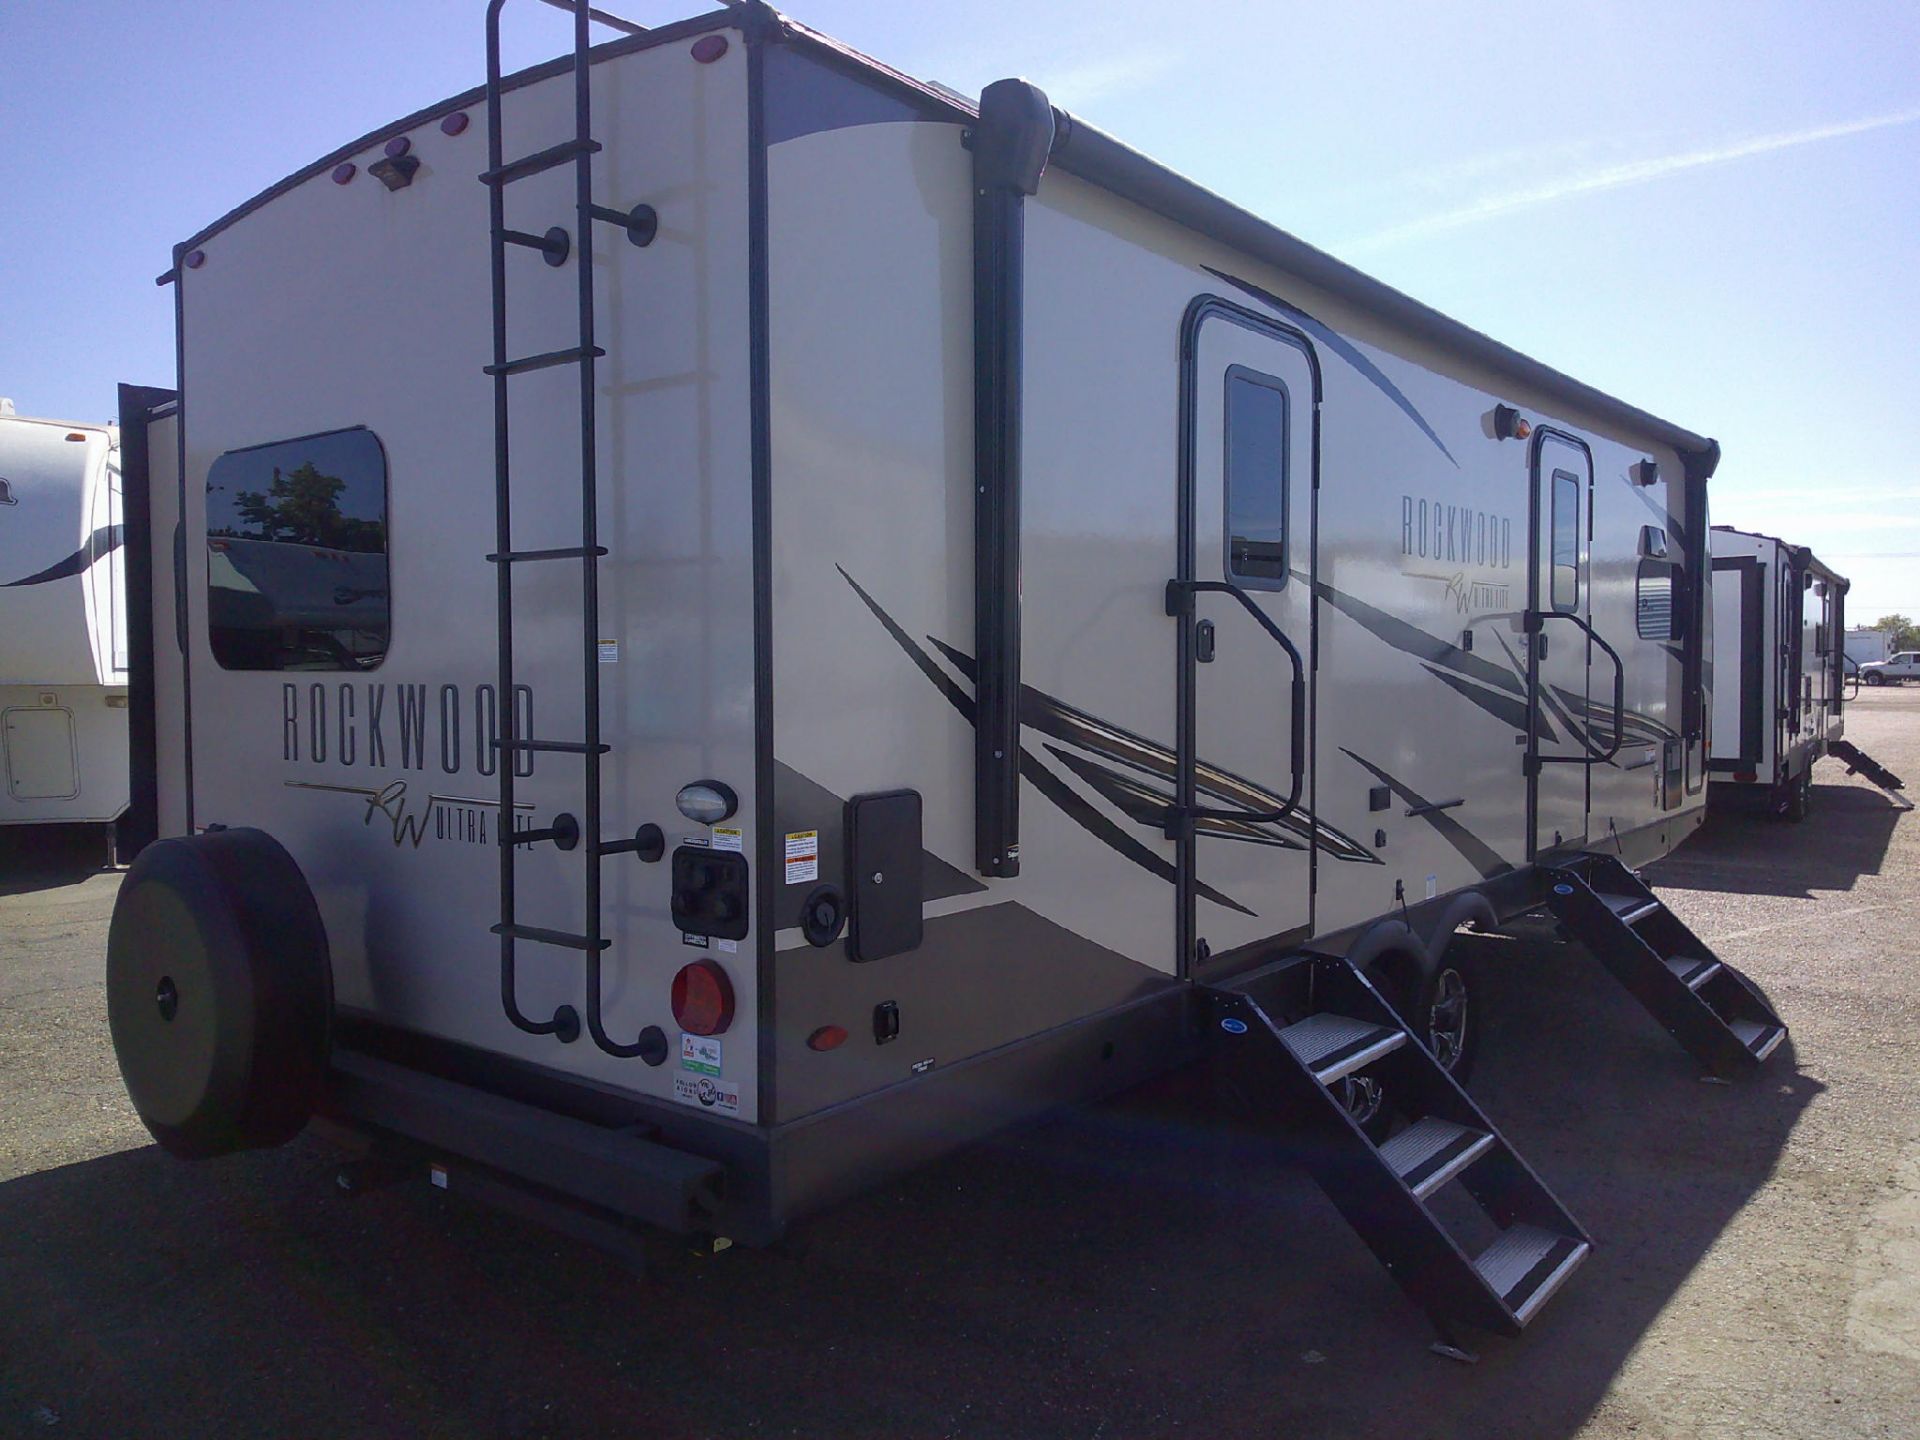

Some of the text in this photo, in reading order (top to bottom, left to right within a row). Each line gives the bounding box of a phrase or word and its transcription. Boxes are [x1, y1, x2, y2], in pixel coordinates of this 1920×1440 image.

[1402, 495, 1510, 569] ROCKWOOD
[283, 682, 535, 777] ROCKWOOD
[436, 805, 487, 845] ULTRA
